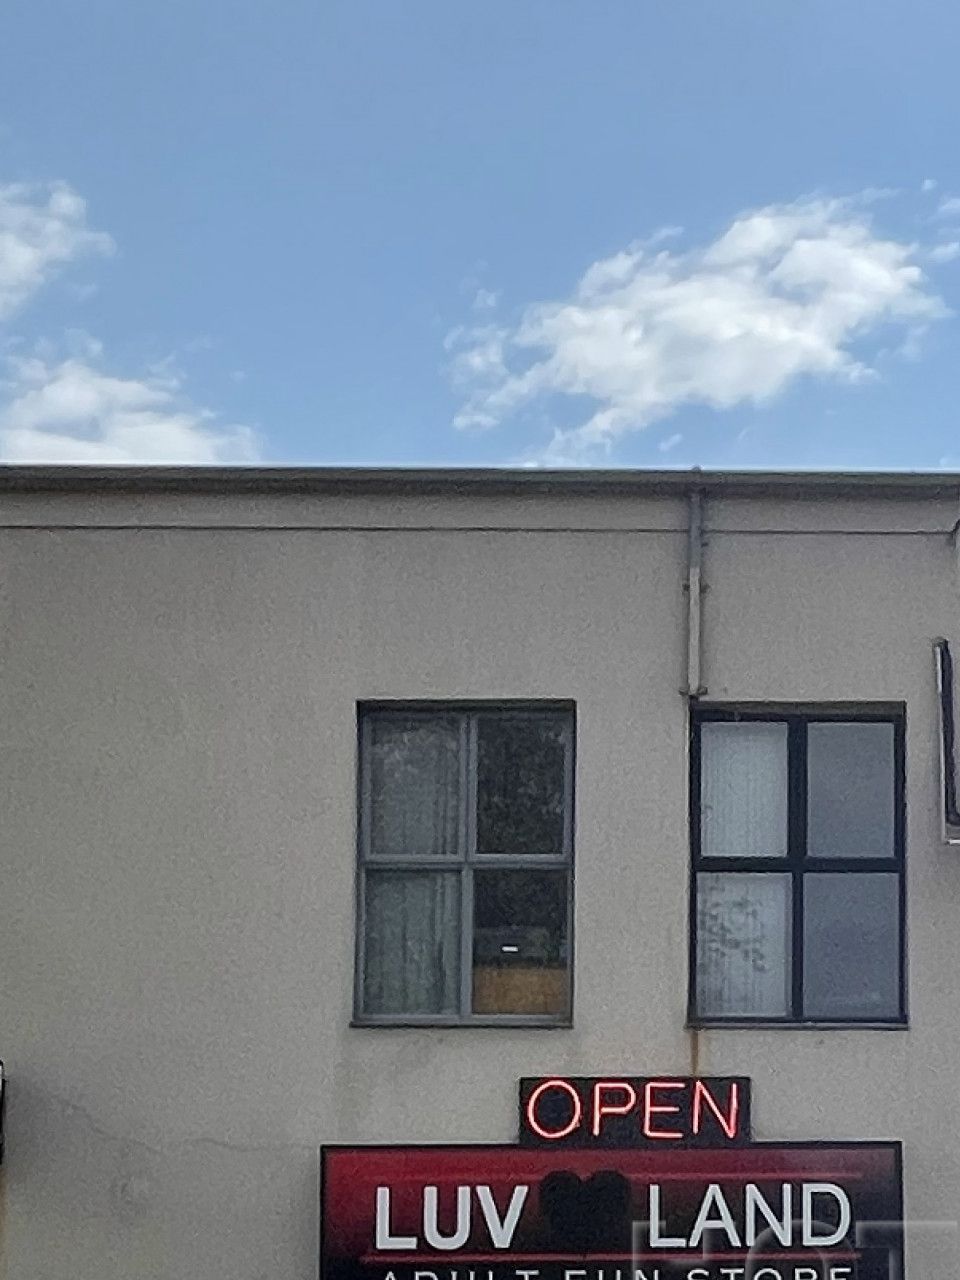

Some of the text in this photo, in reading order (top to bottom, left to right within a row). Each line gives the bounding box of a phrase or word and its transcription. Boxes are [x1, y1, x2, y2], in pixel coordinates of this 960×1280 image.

[526, 1079, 739, 1139] OPEN
[375, 1183, 853, 1250] LUV LAND
